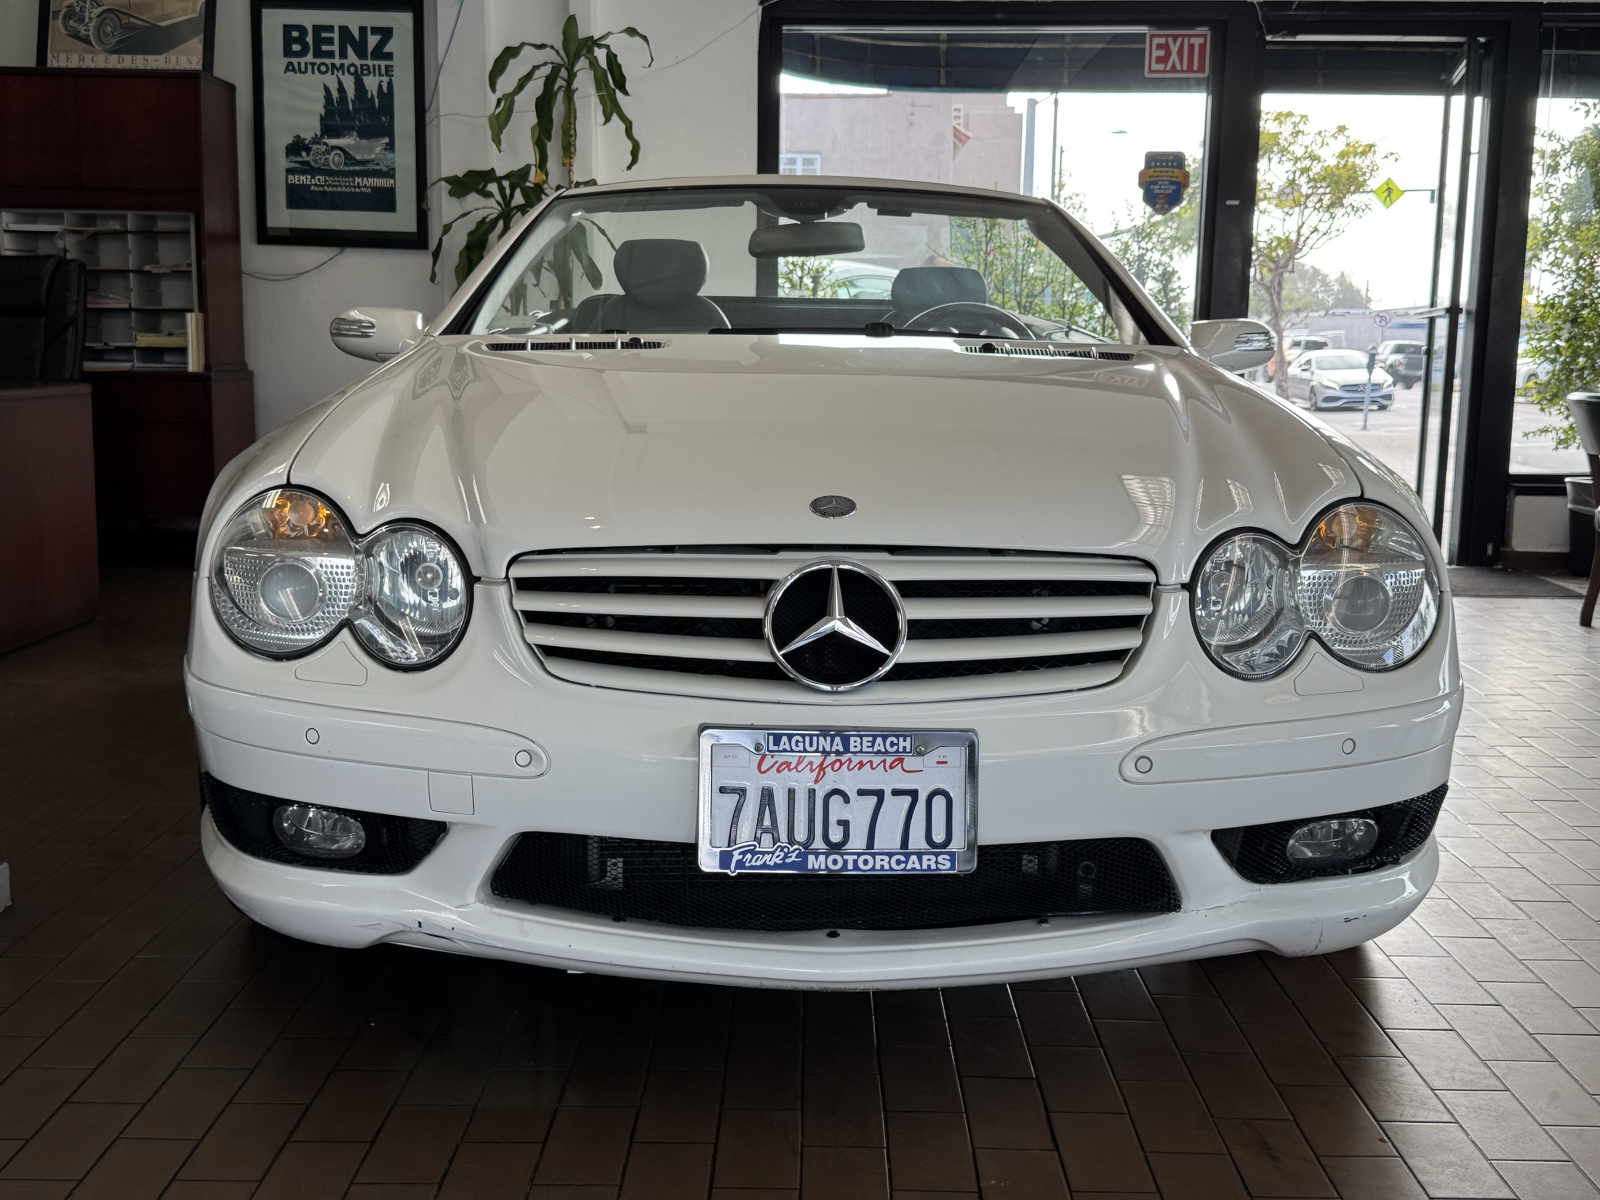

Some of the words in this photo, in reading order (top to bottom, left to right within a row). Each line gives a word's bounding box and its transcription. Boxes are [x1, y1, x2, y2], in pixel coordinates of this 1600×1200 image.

[282, 24, 394, 61] BENZ
[1150, 36, 1205, 72] EXIT
[51, 53, 203, 66] MERCEDES-BENZ
[283, 61, 395, 78] AUTOMOBILE
[768, 735, 843, 752] LAGUNA
[849, 736, 911, 753] BEACH
[757, 754, 923, 785] California
[719, 785, 953, 850] 7AUG770
[730, 843, 803, 874] Frank's
[807, 853, 951, 870] MOTORCARS
